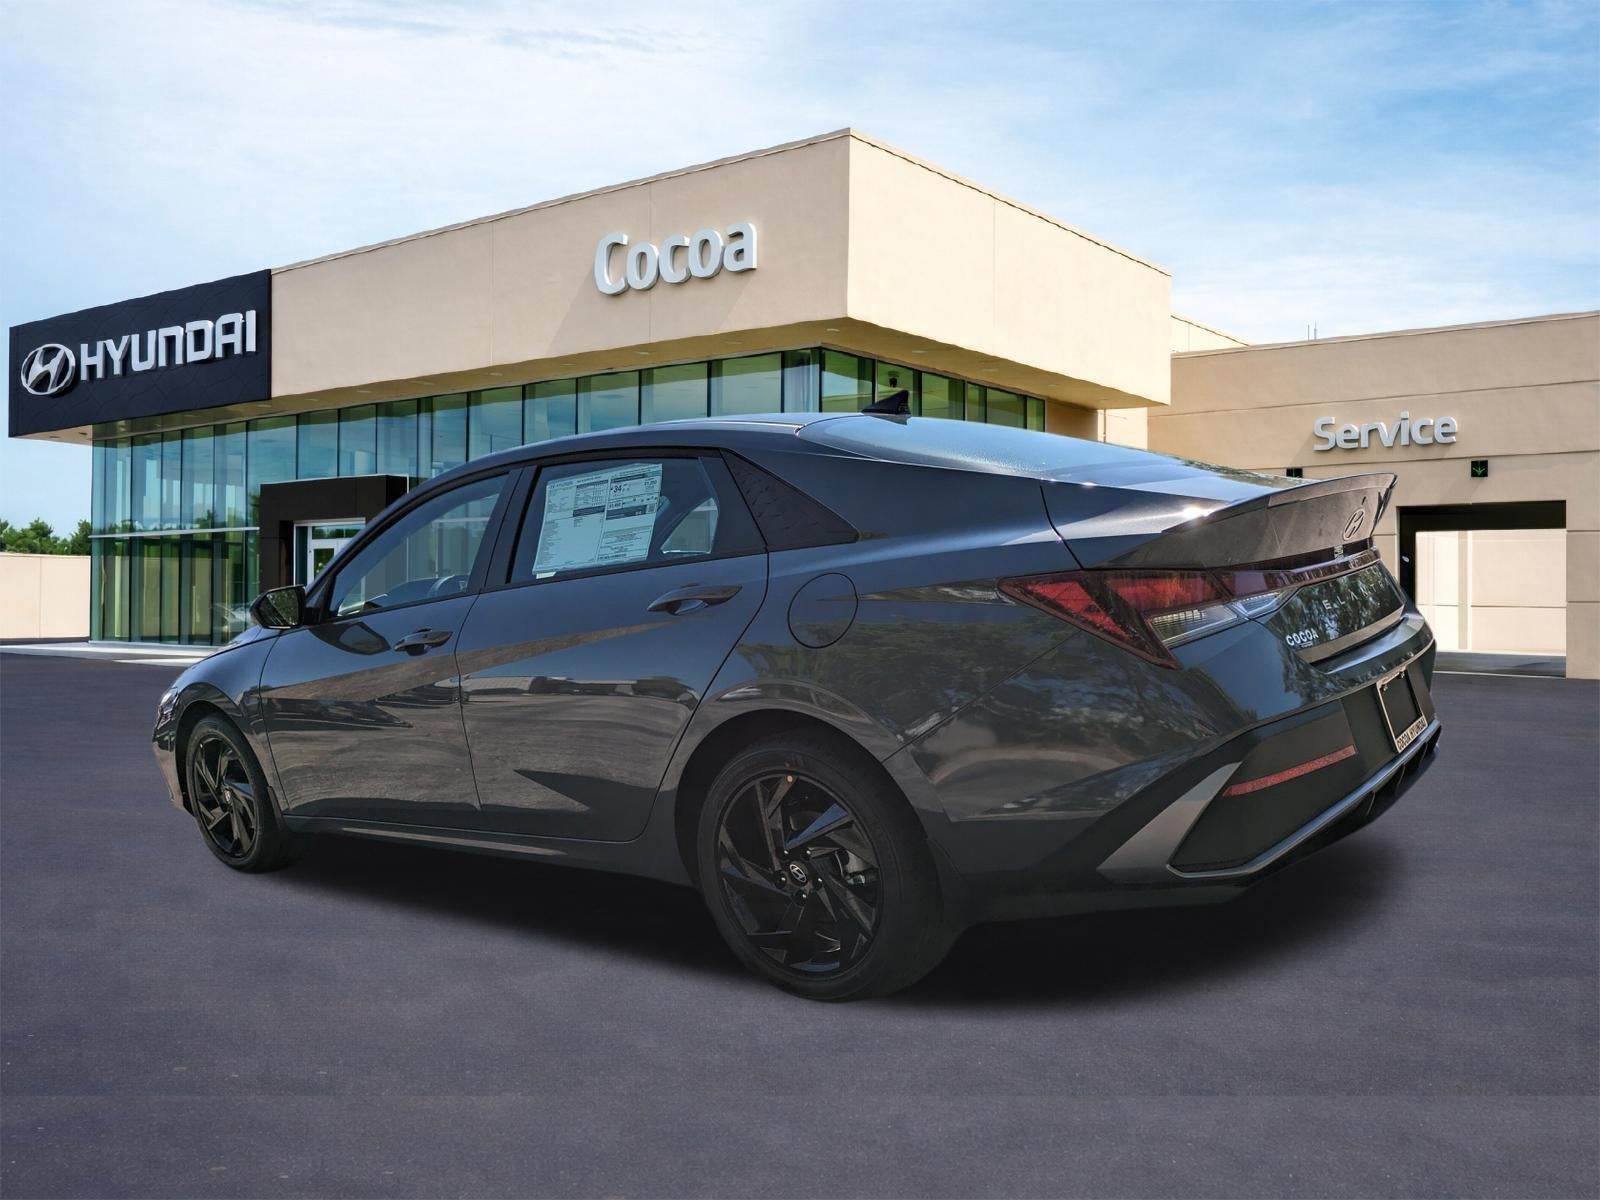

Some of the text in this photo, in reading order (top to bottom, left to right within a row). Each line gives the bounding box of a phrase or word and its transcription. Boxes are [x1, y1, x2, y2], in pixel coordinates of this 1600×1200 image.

[594, 222, 757, 295] Cocoa
[80, 310, 257, 381] HYUNDAI
[1312, 411, 1458, 451] Service
[1285, 628, 1319, 646] COCOA
